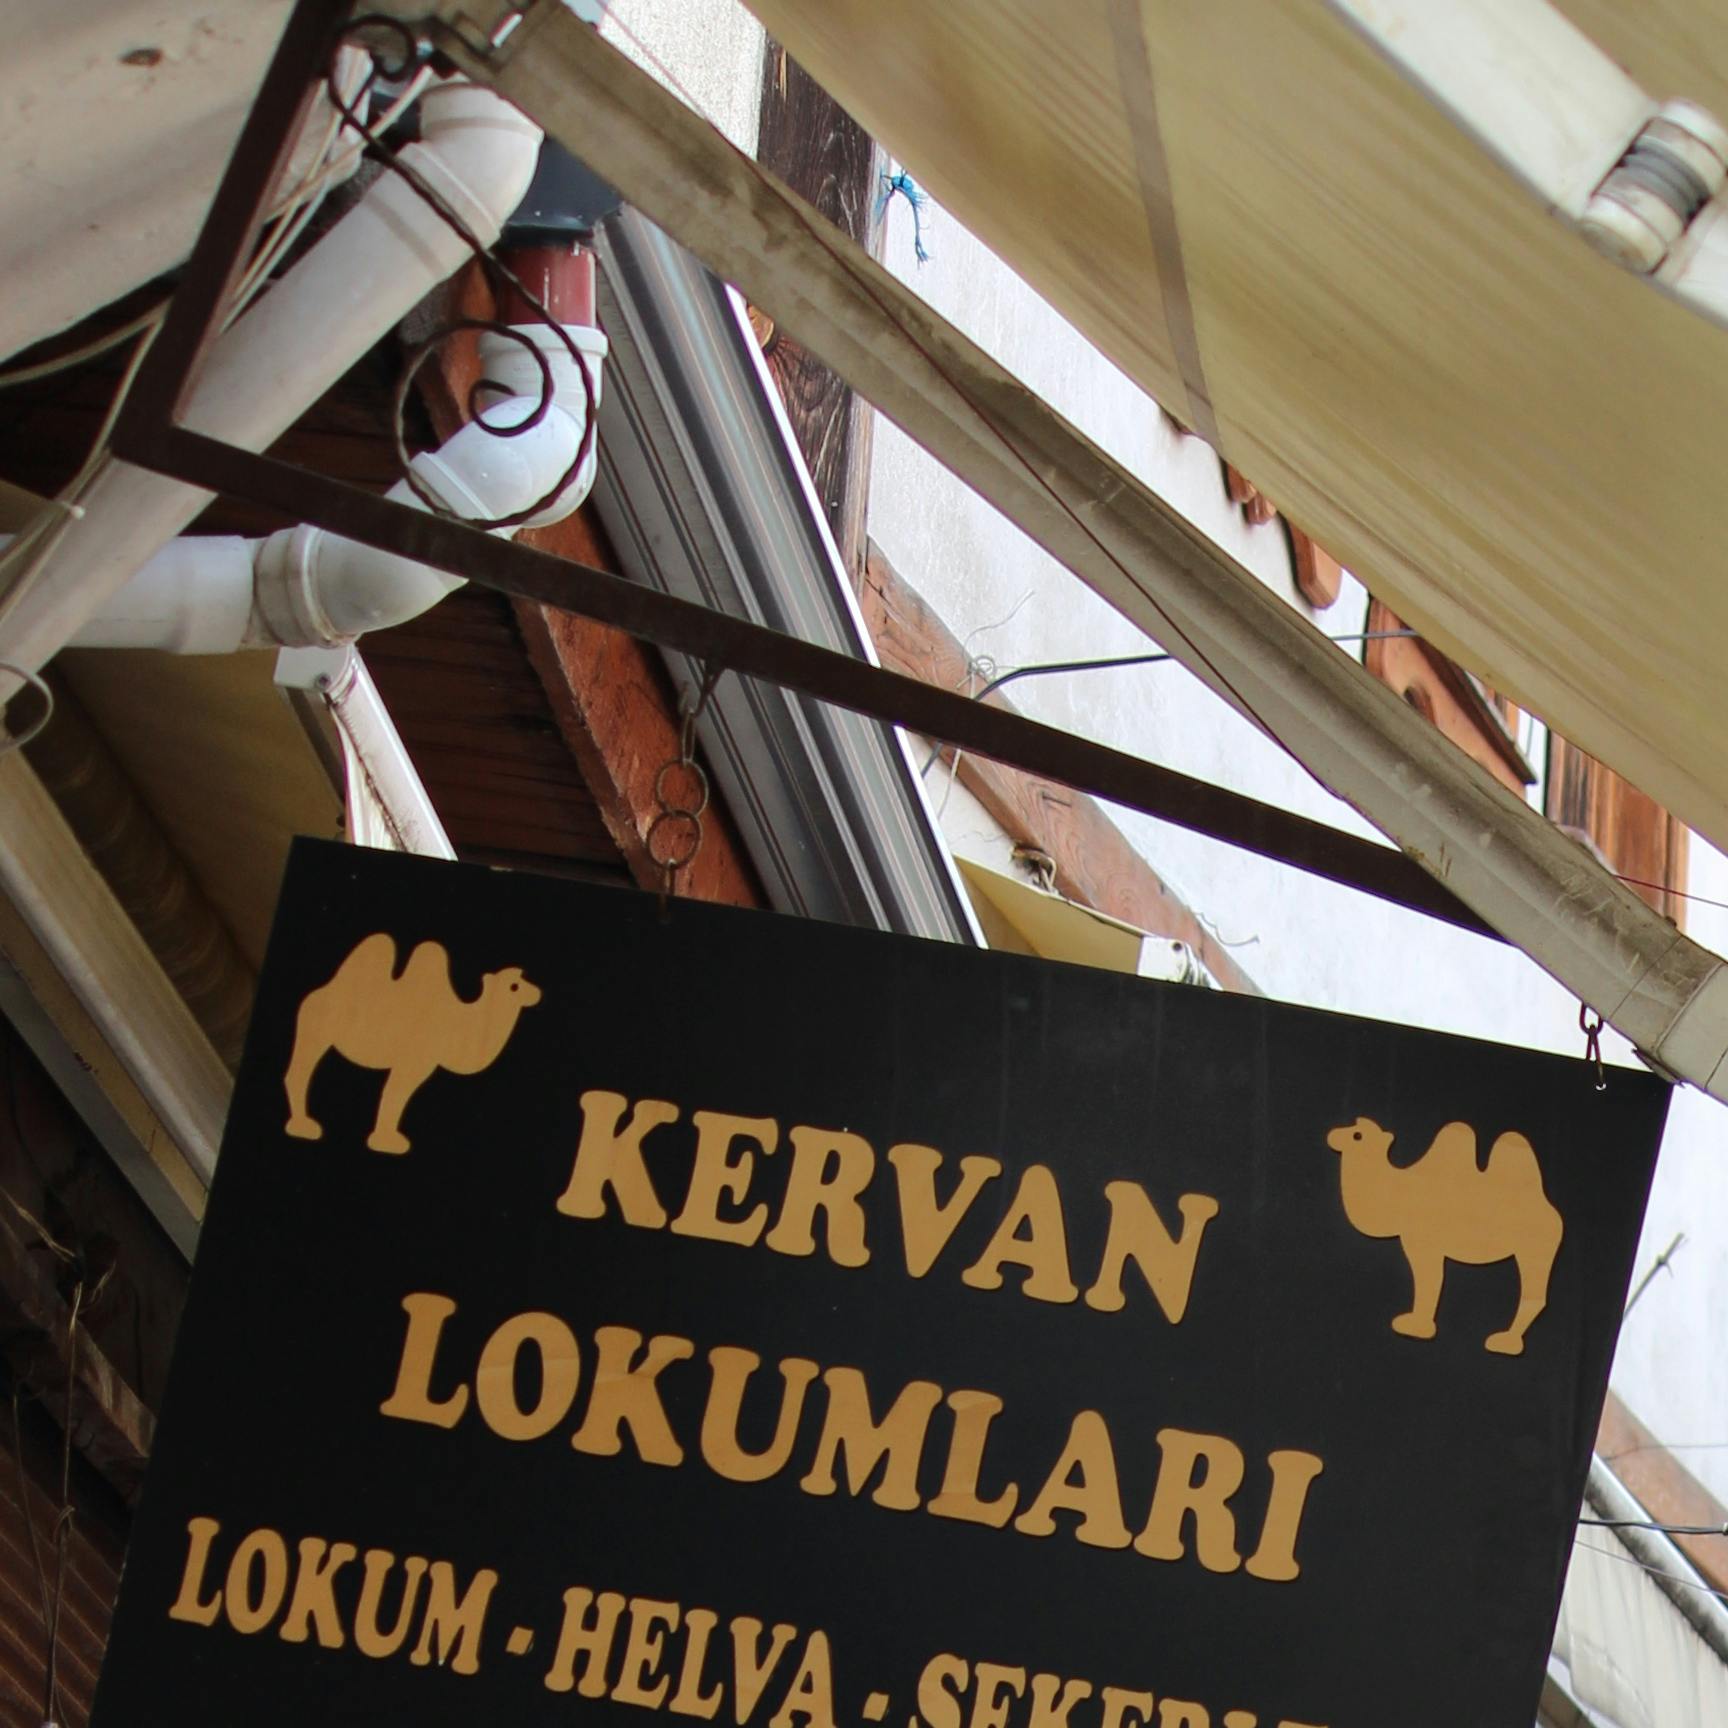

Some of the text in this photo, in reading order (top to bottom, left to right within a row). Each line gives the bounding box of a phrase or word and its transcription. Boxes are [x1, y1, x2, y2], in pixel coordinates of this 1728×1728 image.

[555, 1090, 1219, 1325] KERVAN
[380, 1293, 1323, 1581] LOKUMLARI
[168, 1517, 499, 1676] LOKUM
